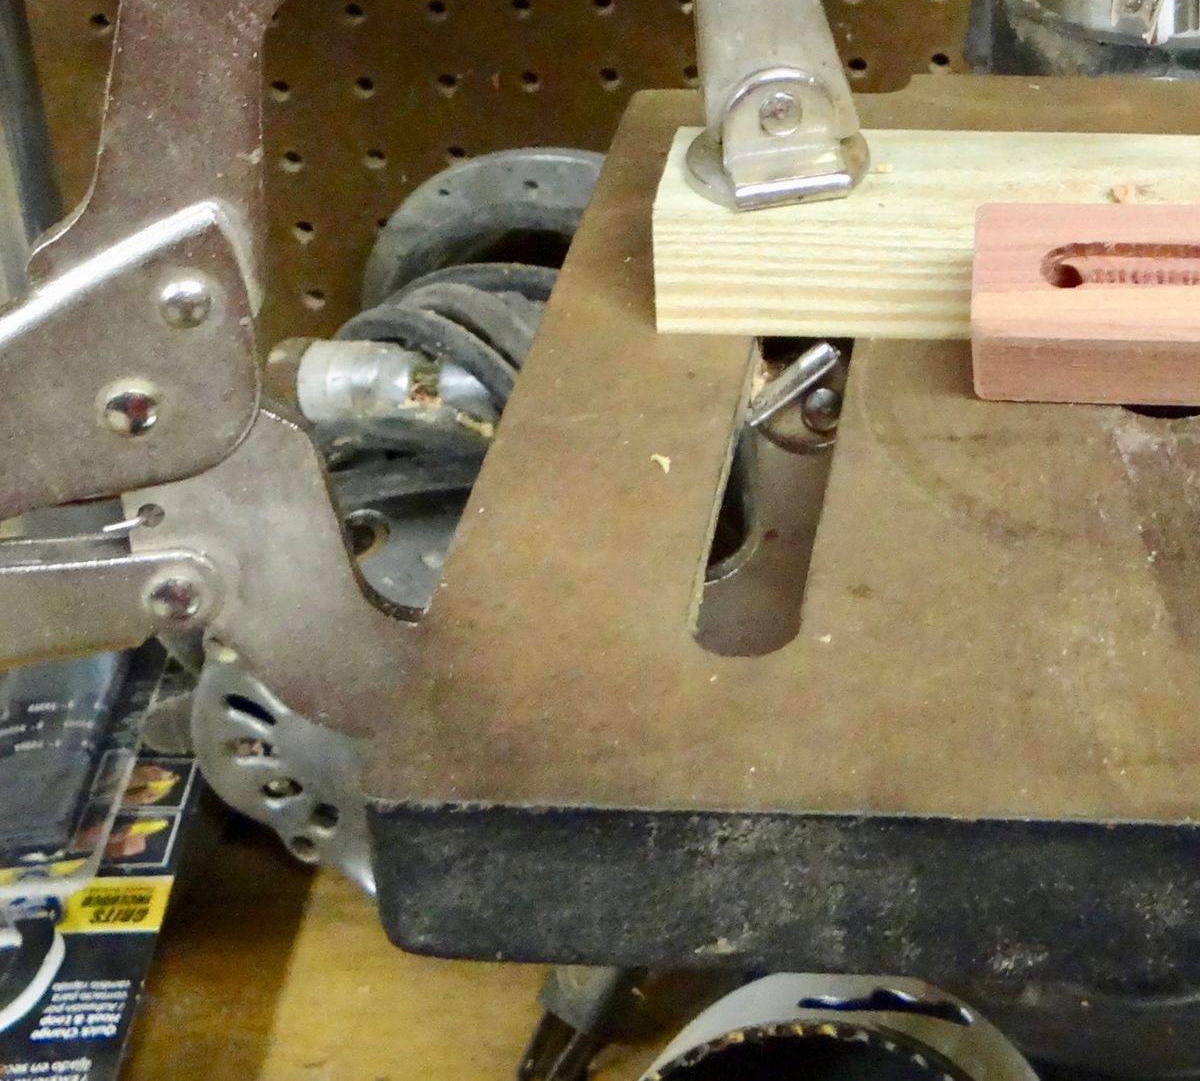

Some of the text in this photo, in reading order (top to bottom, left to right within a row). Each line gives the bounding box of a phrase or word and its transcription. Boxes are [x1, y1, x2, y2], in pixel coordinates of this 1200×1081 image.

[89, 907, 150, 924] GRITS
[30, 1023, 117, 1040] Quick Change
